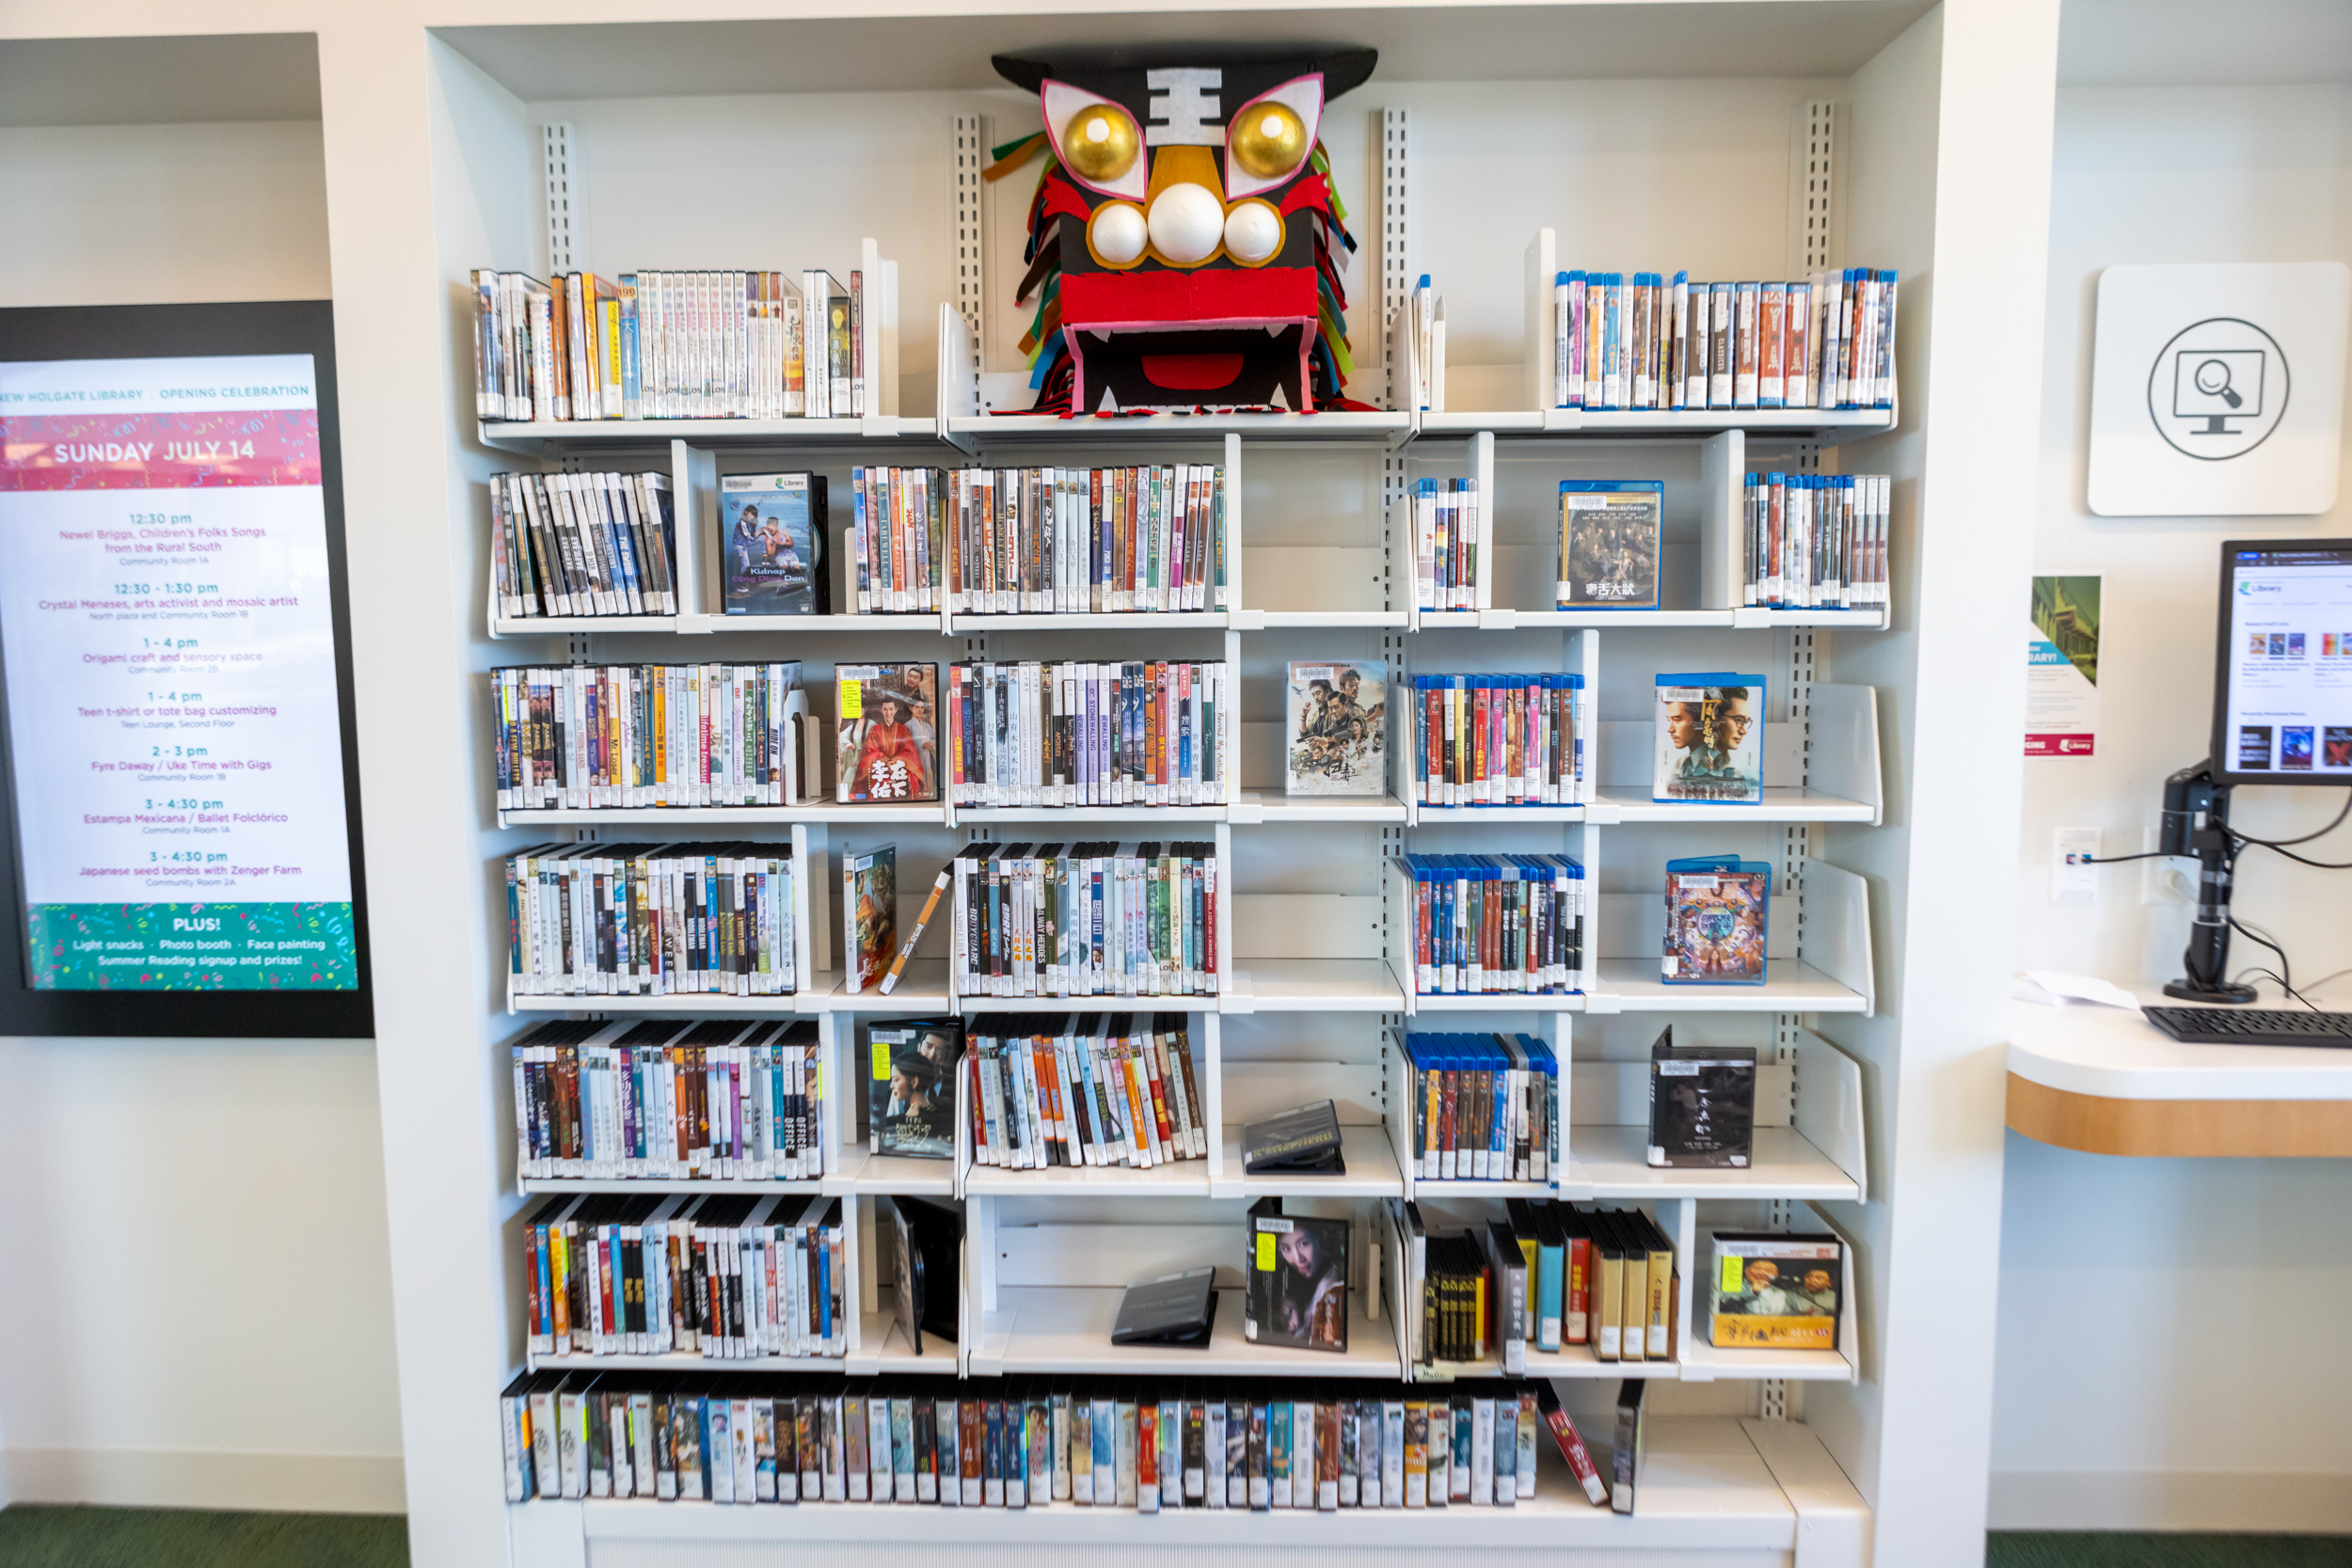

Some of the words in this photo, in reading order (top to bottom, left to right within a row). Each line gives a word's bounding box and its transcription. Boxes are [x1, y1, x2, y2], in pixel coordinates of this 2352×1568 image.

[0, 392, 24, 403] NEW
[28, 391, 86, 402] HOLGATE
[89, 390, 143, 401] LIBRARY
[160, 388, 216, 399] OPENING
[221, 386, 309, 397] CELEBRATION
[55, 441, 153, 462] SUNDAY
[164, 439, 220, 460] JULY
[230, 438, 254, 459] 14
[130, 514, 166, 524] 12:30
[171, 515, 192, 525] pm
[59, 531, 93, 539] Newel
[97, 530, 135, 540] Briggs,
[139, 529, 195, 538] Children's
[199, 528, 228, 537] Folks
[230, 528, 265, 538] Songs
[104, 544, 132, 553] from
[135, 544, 153, 553] the
[156, 543, 184, 552] Rural
[188, 542, 221, 552] South
[619, 536, 628, 550] THE
[621, 551, 633, 576] SWORD
[115, 583, 150, 594] 12:30
[166, 583, 192, 594] 1:30
[198, 585, 218, 594] pm
[1585, 583, 1635, 595] 毒舌大狀
[38, 600, 77, 611] Crystal
[80, 600, 131, 609] Meneses,
[134, 599, 155, 609] arts
[158, 598, 199, 608] activist
[202, 597, 223, 608] and
[227, 597, 266, 607] mosaic
[269, 597, 298, 606] artist
[144, 638, 149, 648] 1
[164, 638, 171, 647] 4
[177, 640, 198, 649] pm
[82, 653, 127, 665] Origami
[130, 653, 155, 662] craft
[160, 653, 180, 662] and
[183, 654, 226, 664] sensory
[2029, 653, 2057, 662] RARY!
[148, 691, 153, 702] 1
[168, 692, 176, 701] 4
[182, 693, 202, 703] pm
[78, 707, 103, 717] Teen
[106, 707, 140, 717] t-shirt
[158, 707, 181, 716] tote
[184, 706, 206, 717] bag
[209, 706, 277, 716] customizing
[1181, 715, 1189, 736] 搜索
[152, 746, 160, 756] 2
[175, 746, 182, 756] 3
[187, 748, 207, 757] pm
[770, 746, 778, 755] ON
[1010, 712, 1019, 785] 山有木兮木有心
[1191, 733, 1200, 772] 岁岁青莲
[91, 761, 116, 772] Fyre
[119, 762, 154, 771] Daway
[167, 761, 187, 770] Uke
[190, 761, 217, 769] Time
[220, 760, 244, 769] with
[247, 760, 272, 770] Gigs
[700, 751, 709, 784] treasur
[147, 800, 152, 809] 3
[167, 800, 198, 809] 4:30
[202, 801, 223, 810] pm
[84, 815, 131, 824] Estampa
[135, 815, 185, 823] Mexicana
[198, 814, 230, 823] Ballet
[232, 814, 288, 822] Folclórico
[151, 852, 157, 862] 3
[172, 851, 201, 862] 4:30
[207, 854, 228, 863] pm
[79, 867, 130, 877] Japanese
[134, 866, 159, 876] seed
[163, 866, 200, 875] bombs
[204, 866, 227, 875] with
[231, 865, 270, 877] Zenger
[274, 865, 301, 875] Farm
[173, 918, 220, 932] PLUS!
[687, 918, 695, 950] MIDDLEMAN
[970, 908, 979, 966] BODYGUARD
[1070, 909, 1078, 958] 微雨燕双飞
[1104, 922, 1113, 945] 问心
[73, 940, 103, 951] Light
[105, 940, 144, 949] snacks
[160, 940, 193, 949] Photo
[197, 940, 231, 949] booth
[246, 940, 274, 949] Face
[278, 940, 325, 951] painting
[98, 956, 146, 965] Summer
[149, 956, 196, 967] Reading
[199, 956, 237, 967] signup
[240, 956, 262, 965] and
[264, 956, 302, 967] prizes!
[1096, 1085, 1108, 1121] ATFORM
[785, 1117, 795, 1150] OFFICE
[797, 1117, 806, 1149] OFFICE
